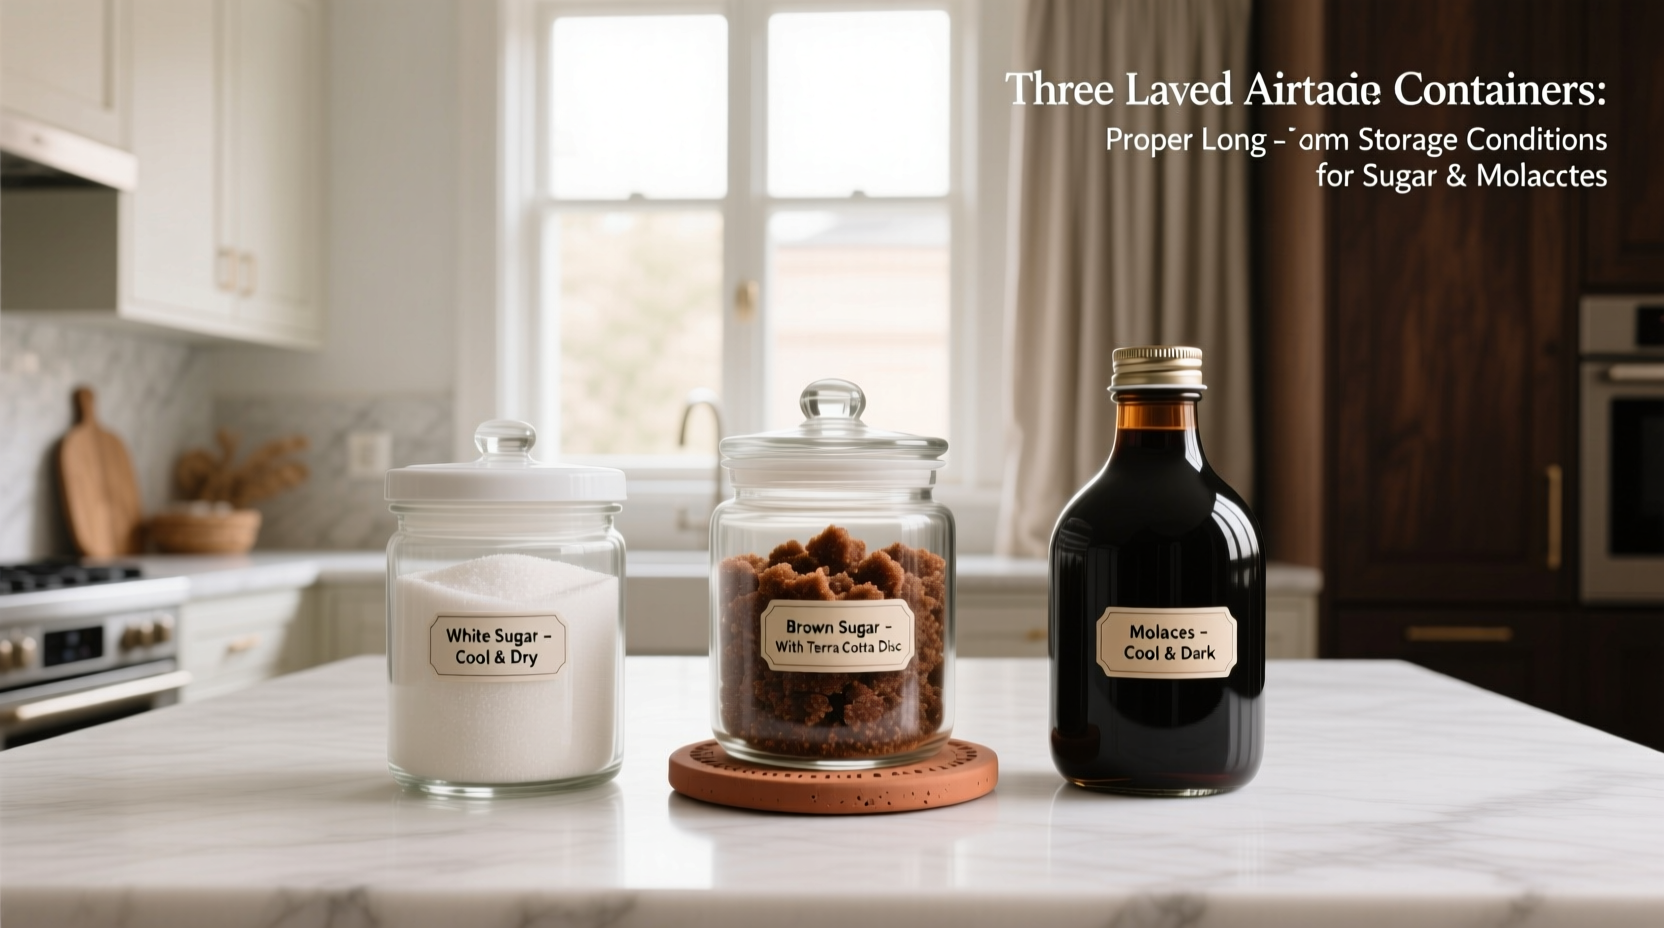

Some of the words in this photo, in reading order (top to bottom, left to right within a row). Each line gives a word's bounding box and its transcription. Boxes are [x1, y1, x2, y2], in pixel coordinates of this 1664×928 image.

[446, 628, 491, 643] White
[495, 628, 539, 648] Sugar
[787, 620, 834, 635] Brown
[839, 620, 880, 639] Sugar
[1130, 624, 1195, 640] Molaces
[776, 640, 804, 654] With
[807, 641, 840, 654] Terra
[842, 641, 875, 654] Cotta
[1124, 645, 1160, 661] Cool
[1165, 646, 1177, 661] &
[1181, 645, 1216, 661] Dark
[456, 650, 490, 665] Cool
[494, 650, 506, 665] &
[511, 649, 539, 668] Dry
